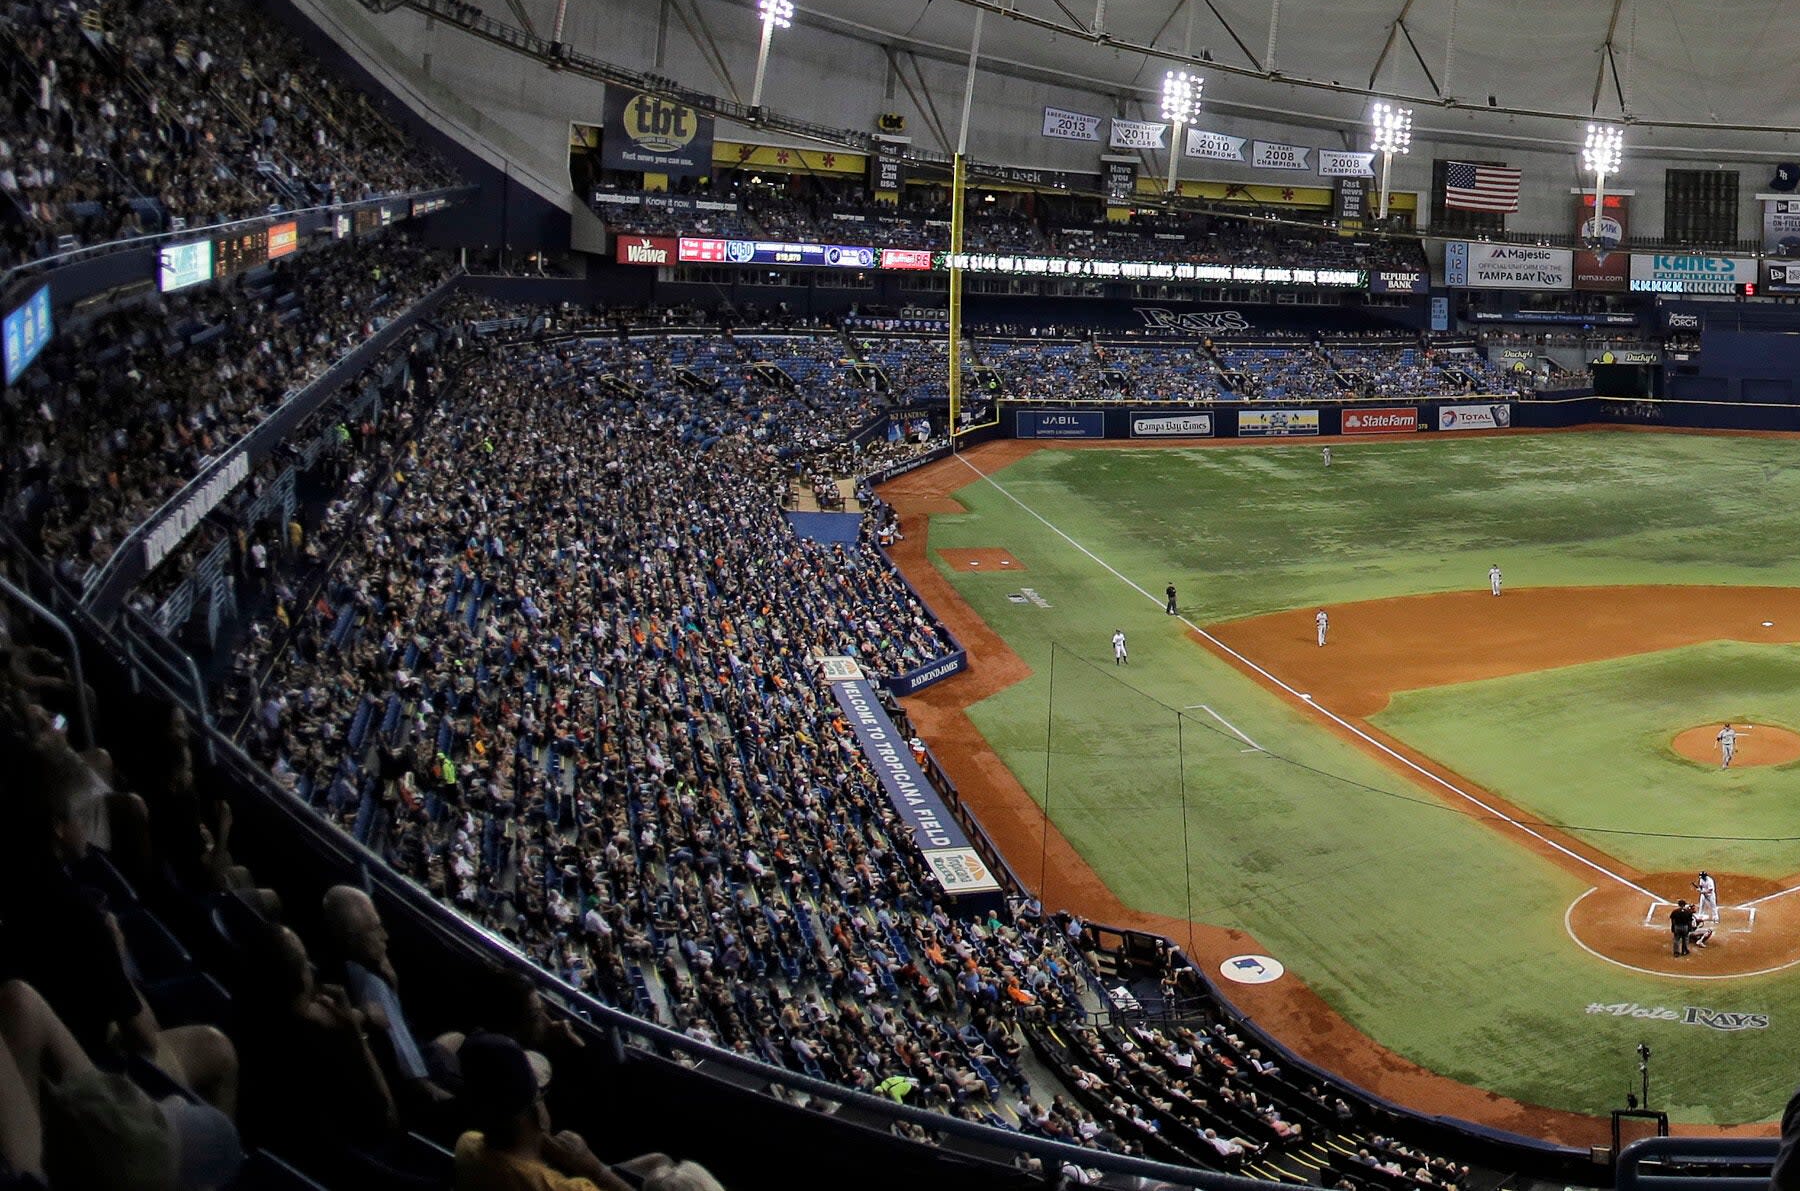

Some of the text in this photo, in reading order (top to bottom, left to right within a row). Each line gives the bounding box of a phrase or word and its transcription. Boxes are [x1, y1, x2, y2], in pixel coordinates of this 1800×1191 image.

[635, 94, 688, 137] tbt
[1058, 119, 1085, 131] 2013
[1049, 128, 1068, 136] WILD
[1124, 129, 1150, 139] 2011
[1200, 139, 1230, 151] 2010
[1190, 147, 1237, 159] CHAMPIONS
[1266, 150, 1294, 160] 2008
[882, 164, 897, 173] you
[1257, 159, 1301, 168] CHAMPIONS
[1332, 159, 1360, 168] 2008
[1110, 164, 1132, 174] Have
[1323, 167, 1367, 175] CHAMPIONS
[882, 171, 897, 179] can
[1112, 174, 1129, 182] you
[880, 180, 897, 188] use.
[1342, 179, 1361, 188] Fast
[645, 196, 691, 208] Know it now.
[627, 245, 667, 263] Wawa
[1450, 244, 1464, 256] 42
[1508, 249, 1551, 261] Majestic
[1451, 259, 1462, 270] 12
[1508, 263, 1538, 271] UNIFORM
[1653, 255, 1735, 272] KANE'S
[1380, 272, 1420, 282] REPUBLIC
[1449, 273, 1463, 284] 66
[1478, 271, 1513, 281] TAMPA
[1516, 272, 1536, 282] BAY
[1578, 274, 1624, 282] remax.com
[1653, 272, 1735, 281] FURNITURE
[1388, 281, 1413, 289] BANK
[1745, 283, 1754, 296] 5
[1669, 319, 1697, 327] PORCH
[1625, 353, 1657, 363] Ducky's
[900, 411, 929, 420] LANDING
[1042, 416, 1079, 425] JABIL
[1459, 413, 1491, 421] TOTAL
[1137, 421, 1207, 434] Tampa Bay Times
[910, 660, 958, 688] RAYMOND JAMES
[841, 681, 951, 846] WELCOME TO TROPICANA FIELD
[1584, 1002, 1680, 1021] #Vote
